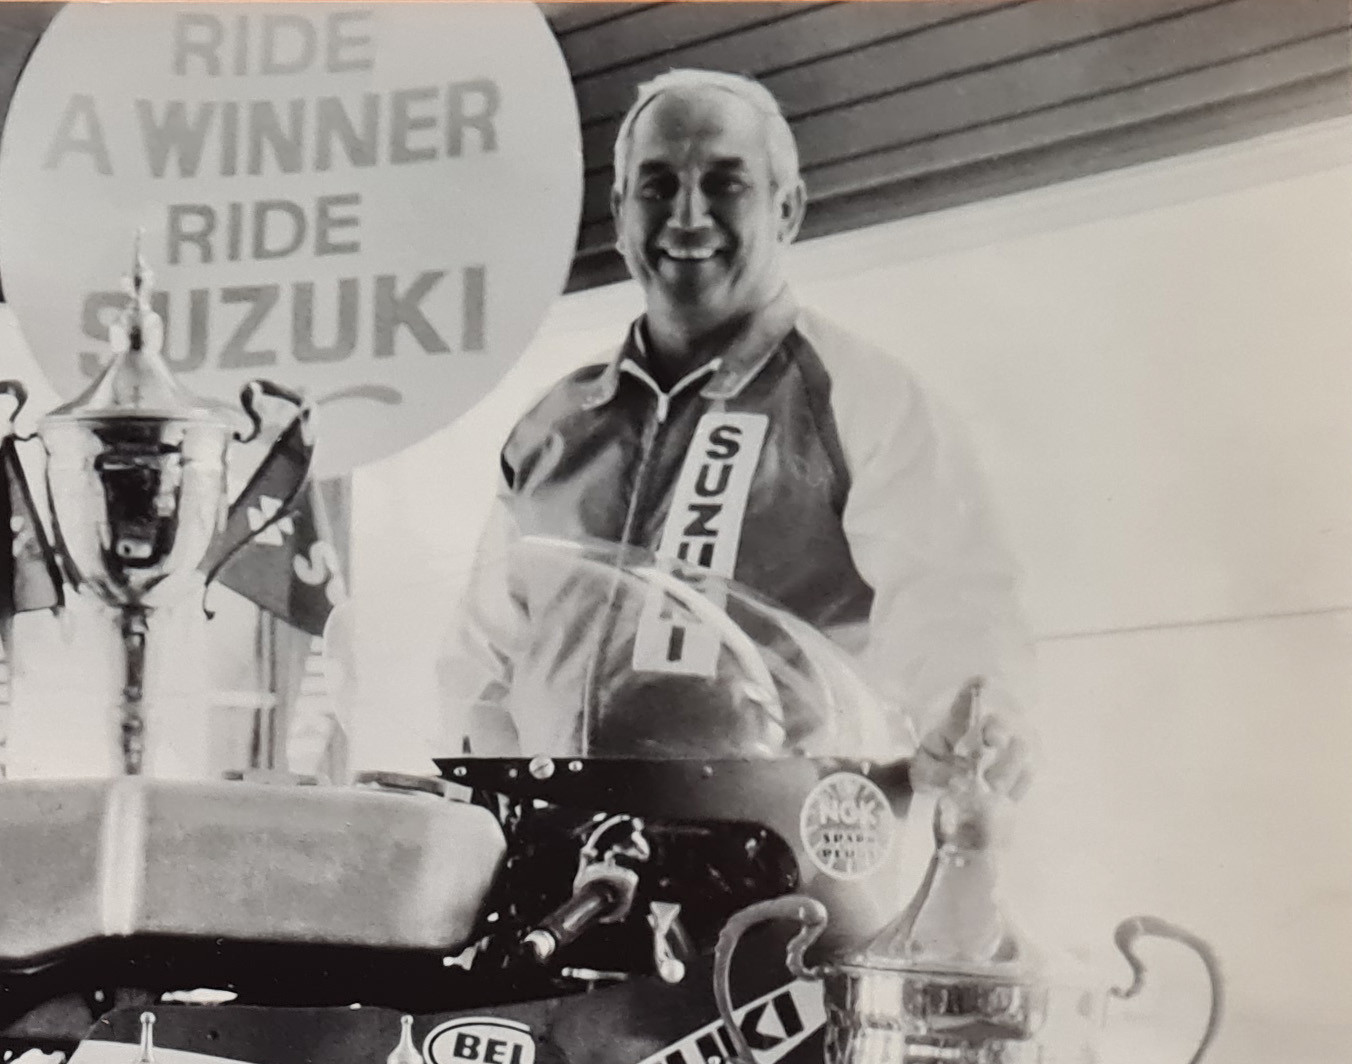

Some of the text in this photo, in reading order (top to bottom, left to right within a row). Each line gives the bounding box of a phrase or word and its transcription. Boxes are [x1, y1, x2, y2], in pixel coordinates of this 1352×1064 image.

[173, 12, 376, 78] RIDE
[42, 78, 502, 178] A WINNER
[167, 194, 361, 265] RIDE
[78, 264, 488, 377] SUZUKI
